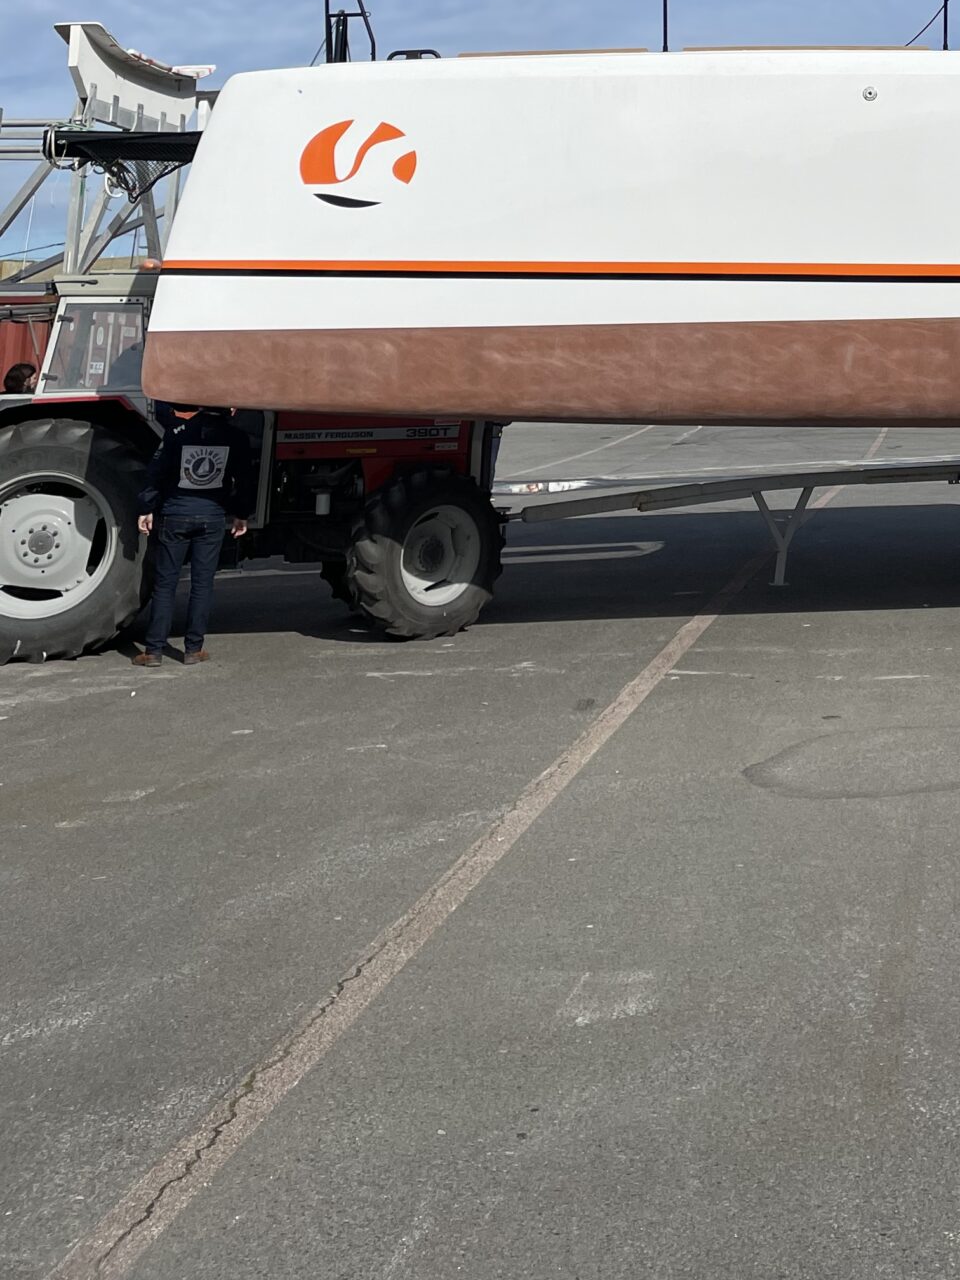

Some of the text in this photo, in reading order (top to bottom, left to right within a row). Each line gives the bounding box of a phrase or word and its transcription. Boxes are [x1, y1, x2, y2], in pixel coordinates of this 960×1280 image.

[283, 431, 374, 441] MASSEY FERGUSON
[406, 427, 450, 438] 390T
